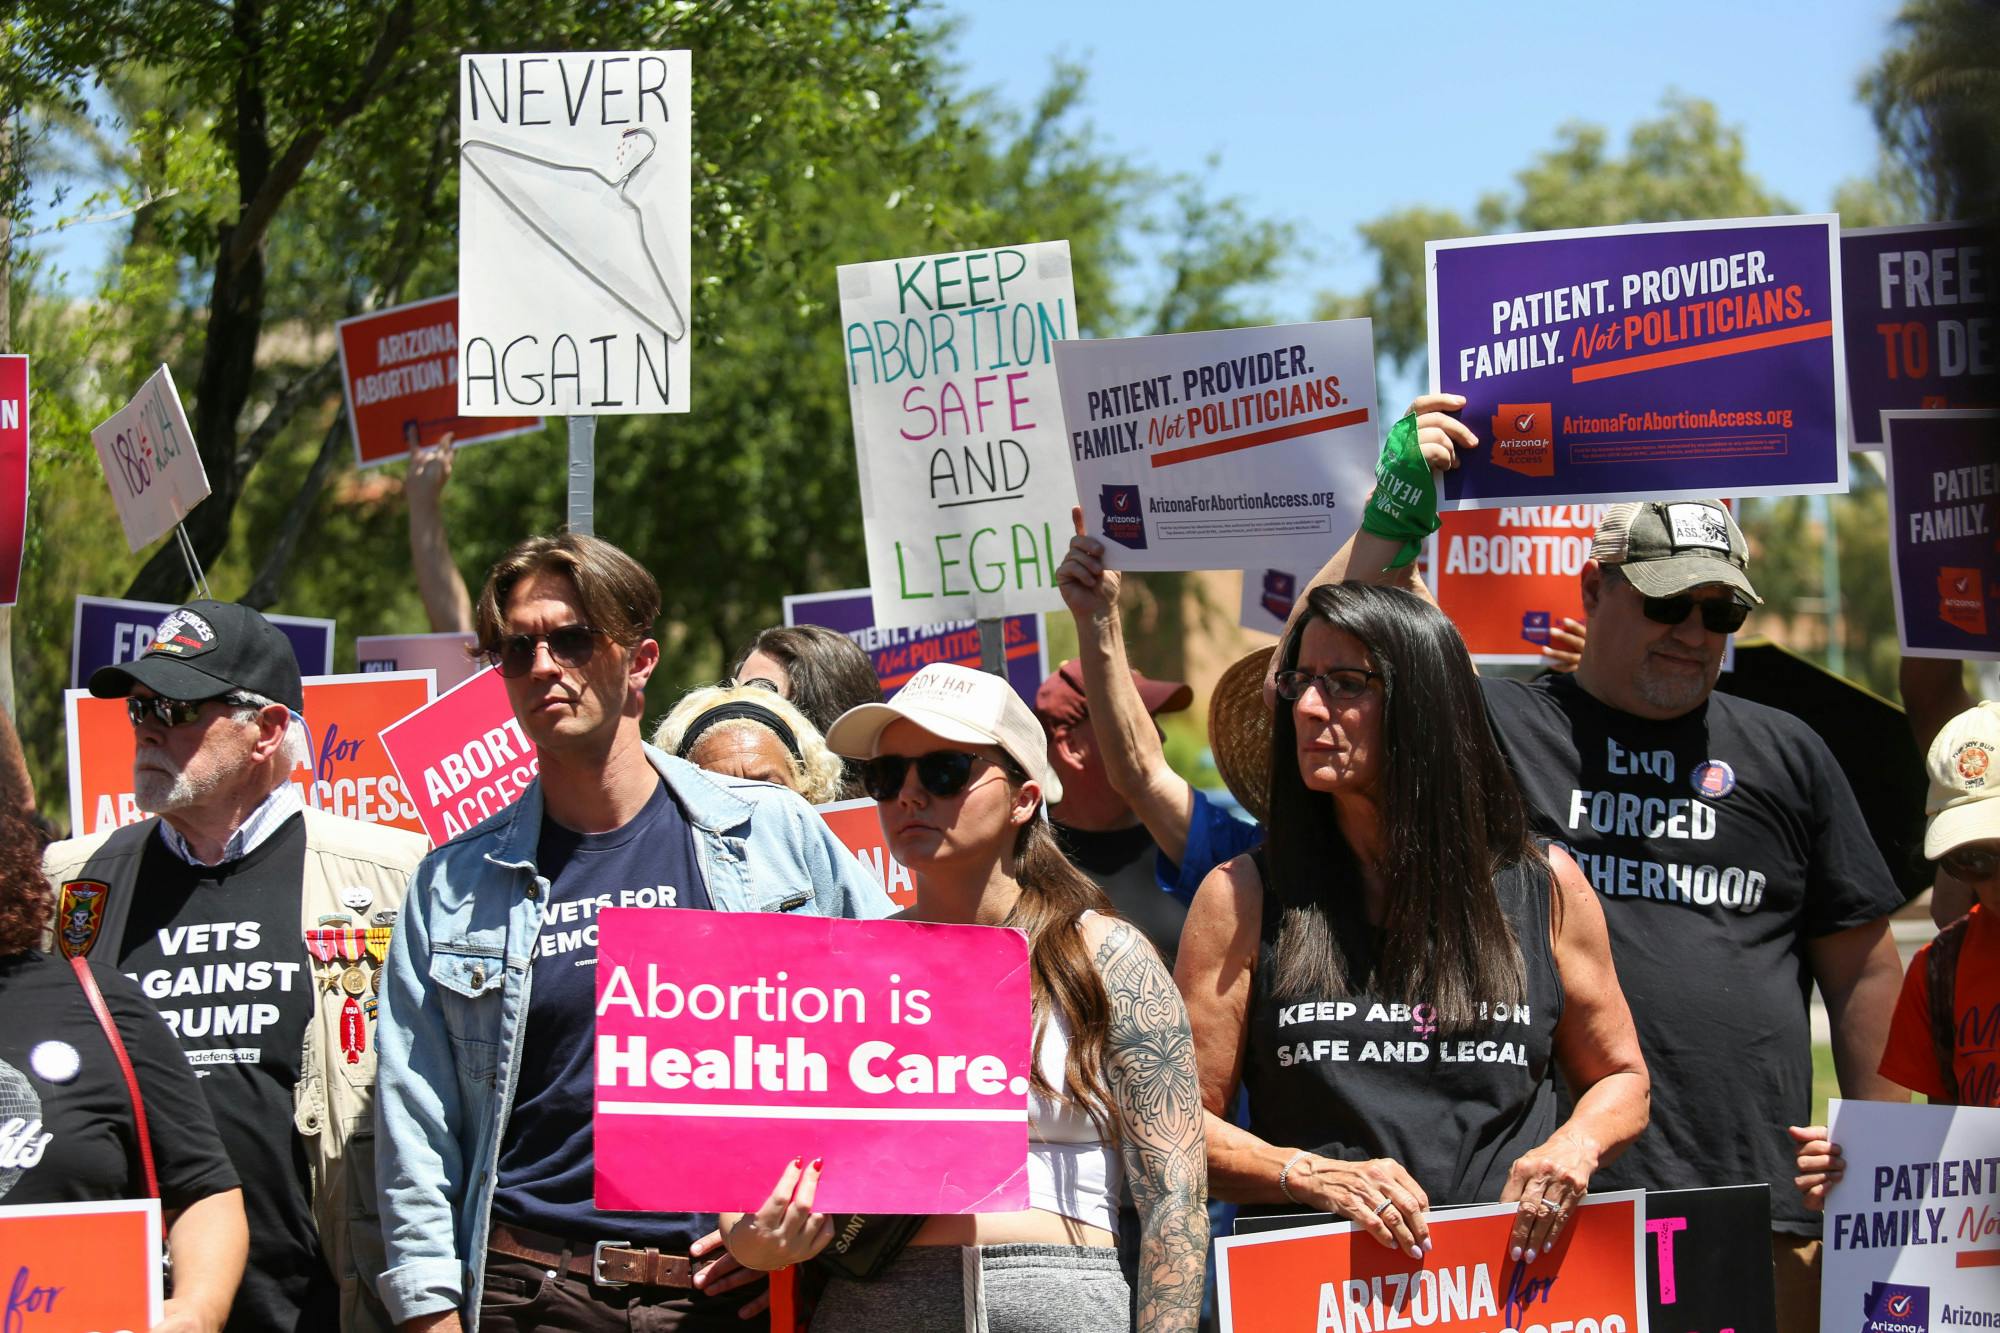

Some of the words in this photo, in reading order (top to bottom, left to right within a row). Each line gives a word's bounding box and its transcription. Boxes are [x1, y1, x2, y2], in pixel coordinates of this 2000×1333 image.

[469, 57, 669, 126] NEVER
[895, 250, 1026, 314] KEEP
[1492, 280, 1615, 335] PATIENT.
[1622, 250, 1775, 309] PROVIDER.
[377, 321, 459, 367] ARIZONA
[847, 299, 1067, 385] ABORTION
[1459, 330, 1564, 382] FAMILY.
[1571, 322, 1621, 358] Not
[1624, 285, 1811, 350] POLITICIANS.
[1876, 322, 1929, 380] TO
[355, 358, 445, 407] ABORTION
[466, 333, 669, 406] AGAIN
[1087, 374, 1179, 421] PATIENT.
[1182, 344, 1315, 401] PROVIDER.
[900, 371, 1036, 440] SAFE
[1072, 420, 1144, 461] FAMILY.
[1148, 413, 1187, 447] Not
[1186, 375, 1348, 439] POLITICIANS.
[1563, 407, 1793, 436] ArizonaForAbortionAccess.org
[930, 439, 1030, 499] AND
[1500, 438, 1541, 448] Arizona
[1149, 491, 1336, 514] ArizonaForAbortionAccess.org
[1498, 504, 1601, 529] ARIZO
[1910, 503, 1989, 544] FAMILY.
[895, 522, 1062, 600] LEGAL
[178, 610, 215, 642] FORCES
[943, 677, 976, 693] HAT
[319, 723, 365, 782] for
[1568, 789, 1716, 841] FORCED
[1552, 840, 1767, 914] THERHOOD
[544, 893, 613, 926] VETS
[620, 885, 677, 909] FOR
[157, 921, 261, 957] VETS
[533, 924, 599, 959] EMO
[124, 961, 300, 1000] GAINST
[597, 964, 866, 1024] Abortion
[890, 973, 932, 1026] is
[158, 1003, 280, 1038] RUMP
[345, 1006, 359, 1014] USA
[1278, 1001, 1356, 1028] KEEP
[598, 1036, 828, 1093] Health
[848, 1040, 1029, 1096] Care.
[1277, 1039, 1350, 1067] SAFE
[1358, 1040, 1430, 1063] AND
[1439, 1040, 1528, 1067] LEGAL
[1873, 1157, 2000, 1202] PATIENT
[1833, 1207, 1948, 1250] FAMILY.
[4, 1265, 67, 1333] for
[1315, 1263, 1498, 1333] ARIZONA
[1505, 1259, 1560, 1331] for
